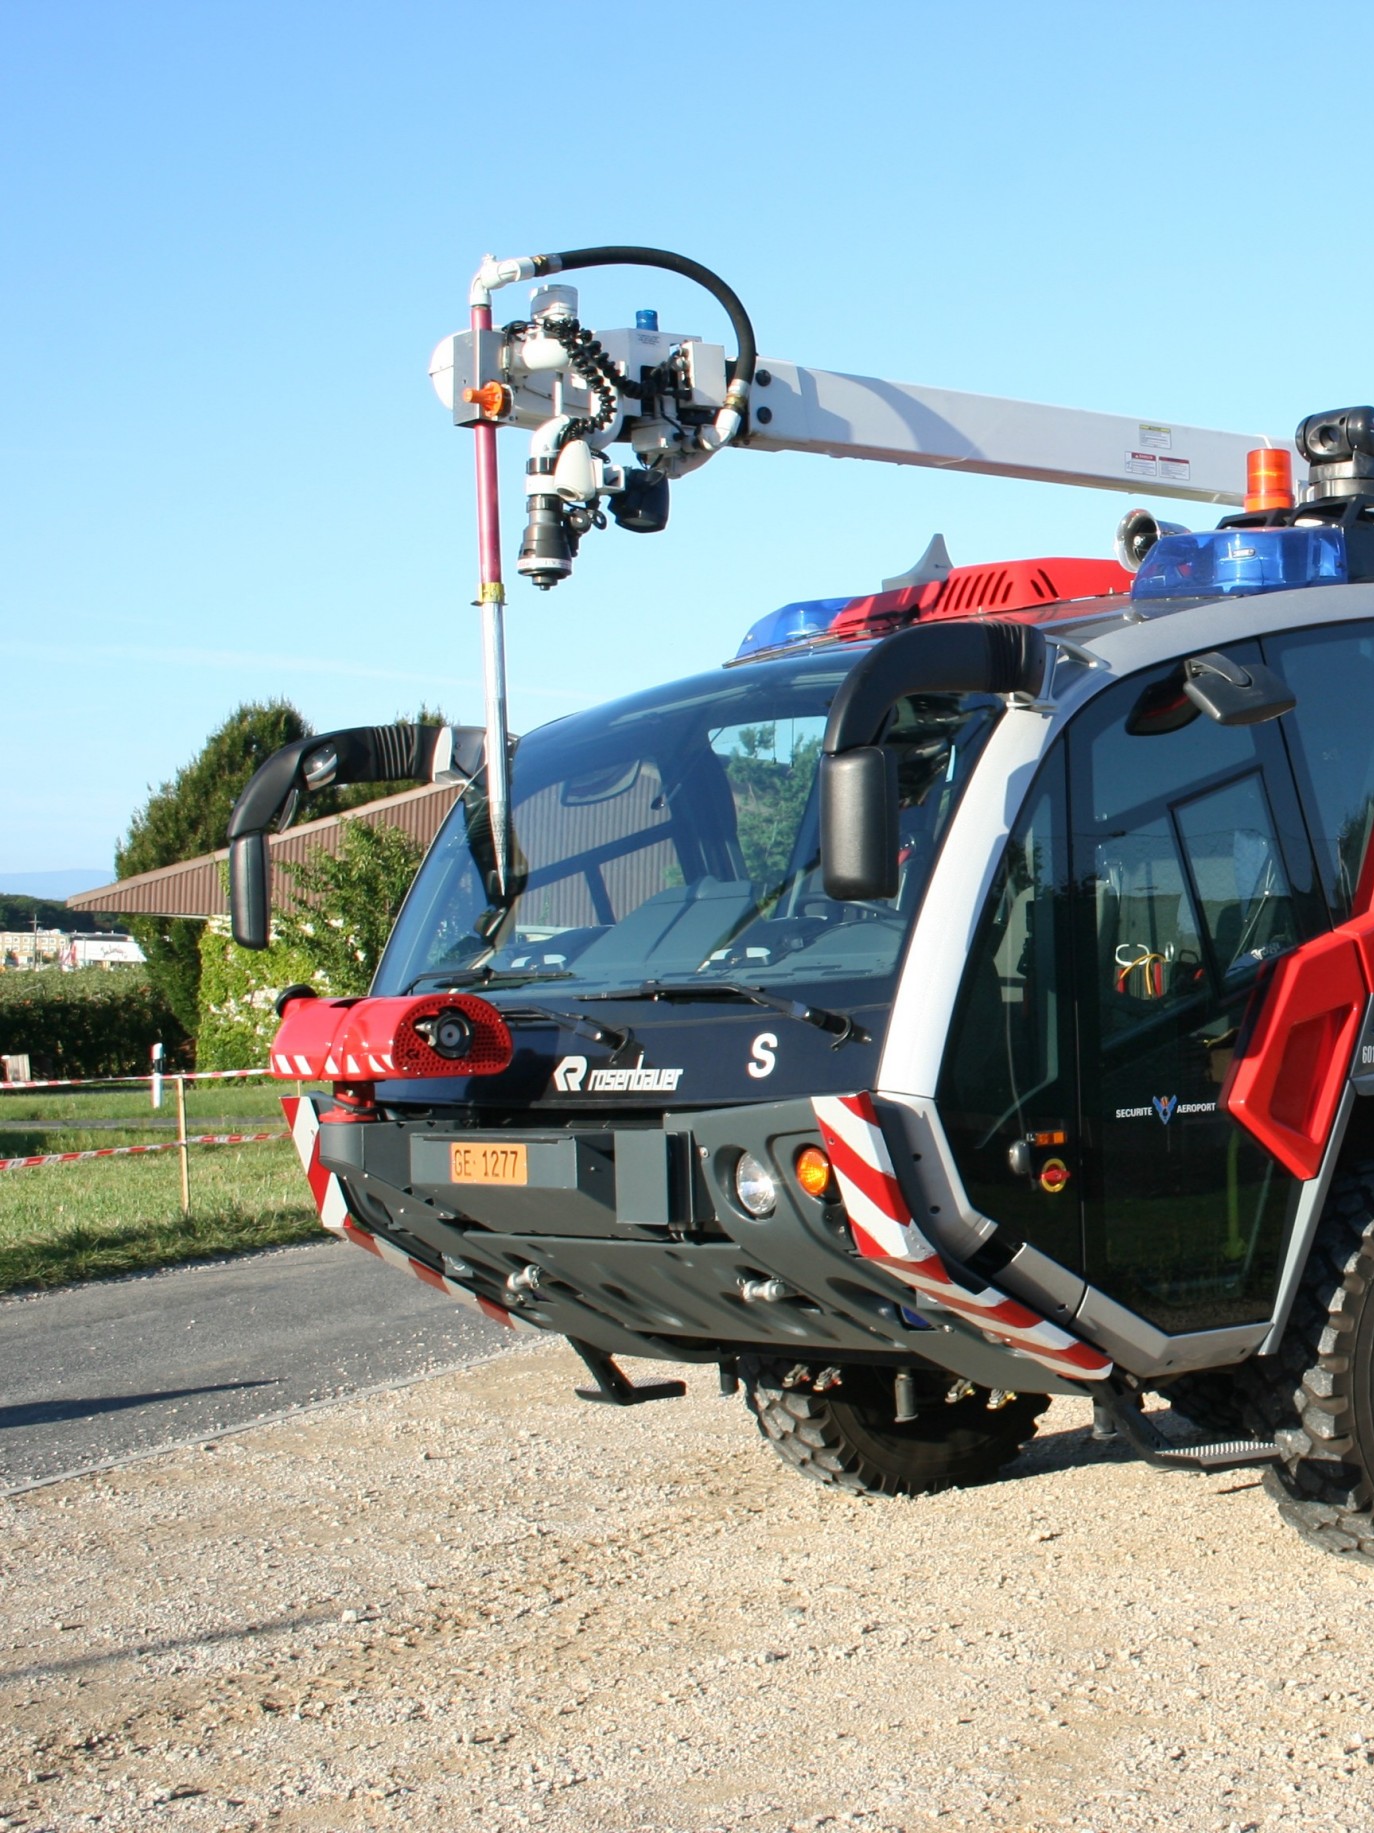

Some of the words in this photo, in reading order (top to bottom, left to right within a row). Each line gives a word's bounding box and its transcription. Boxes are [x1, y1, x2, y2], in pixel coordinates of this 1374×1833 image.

[747, 1032, 778, 1079] S
[1116, 1107, 1153, 1118] SECURITE
[1176, 1102, 1216, 1114] AEROPORT
[482, 1150, 518, 1178] 1277
